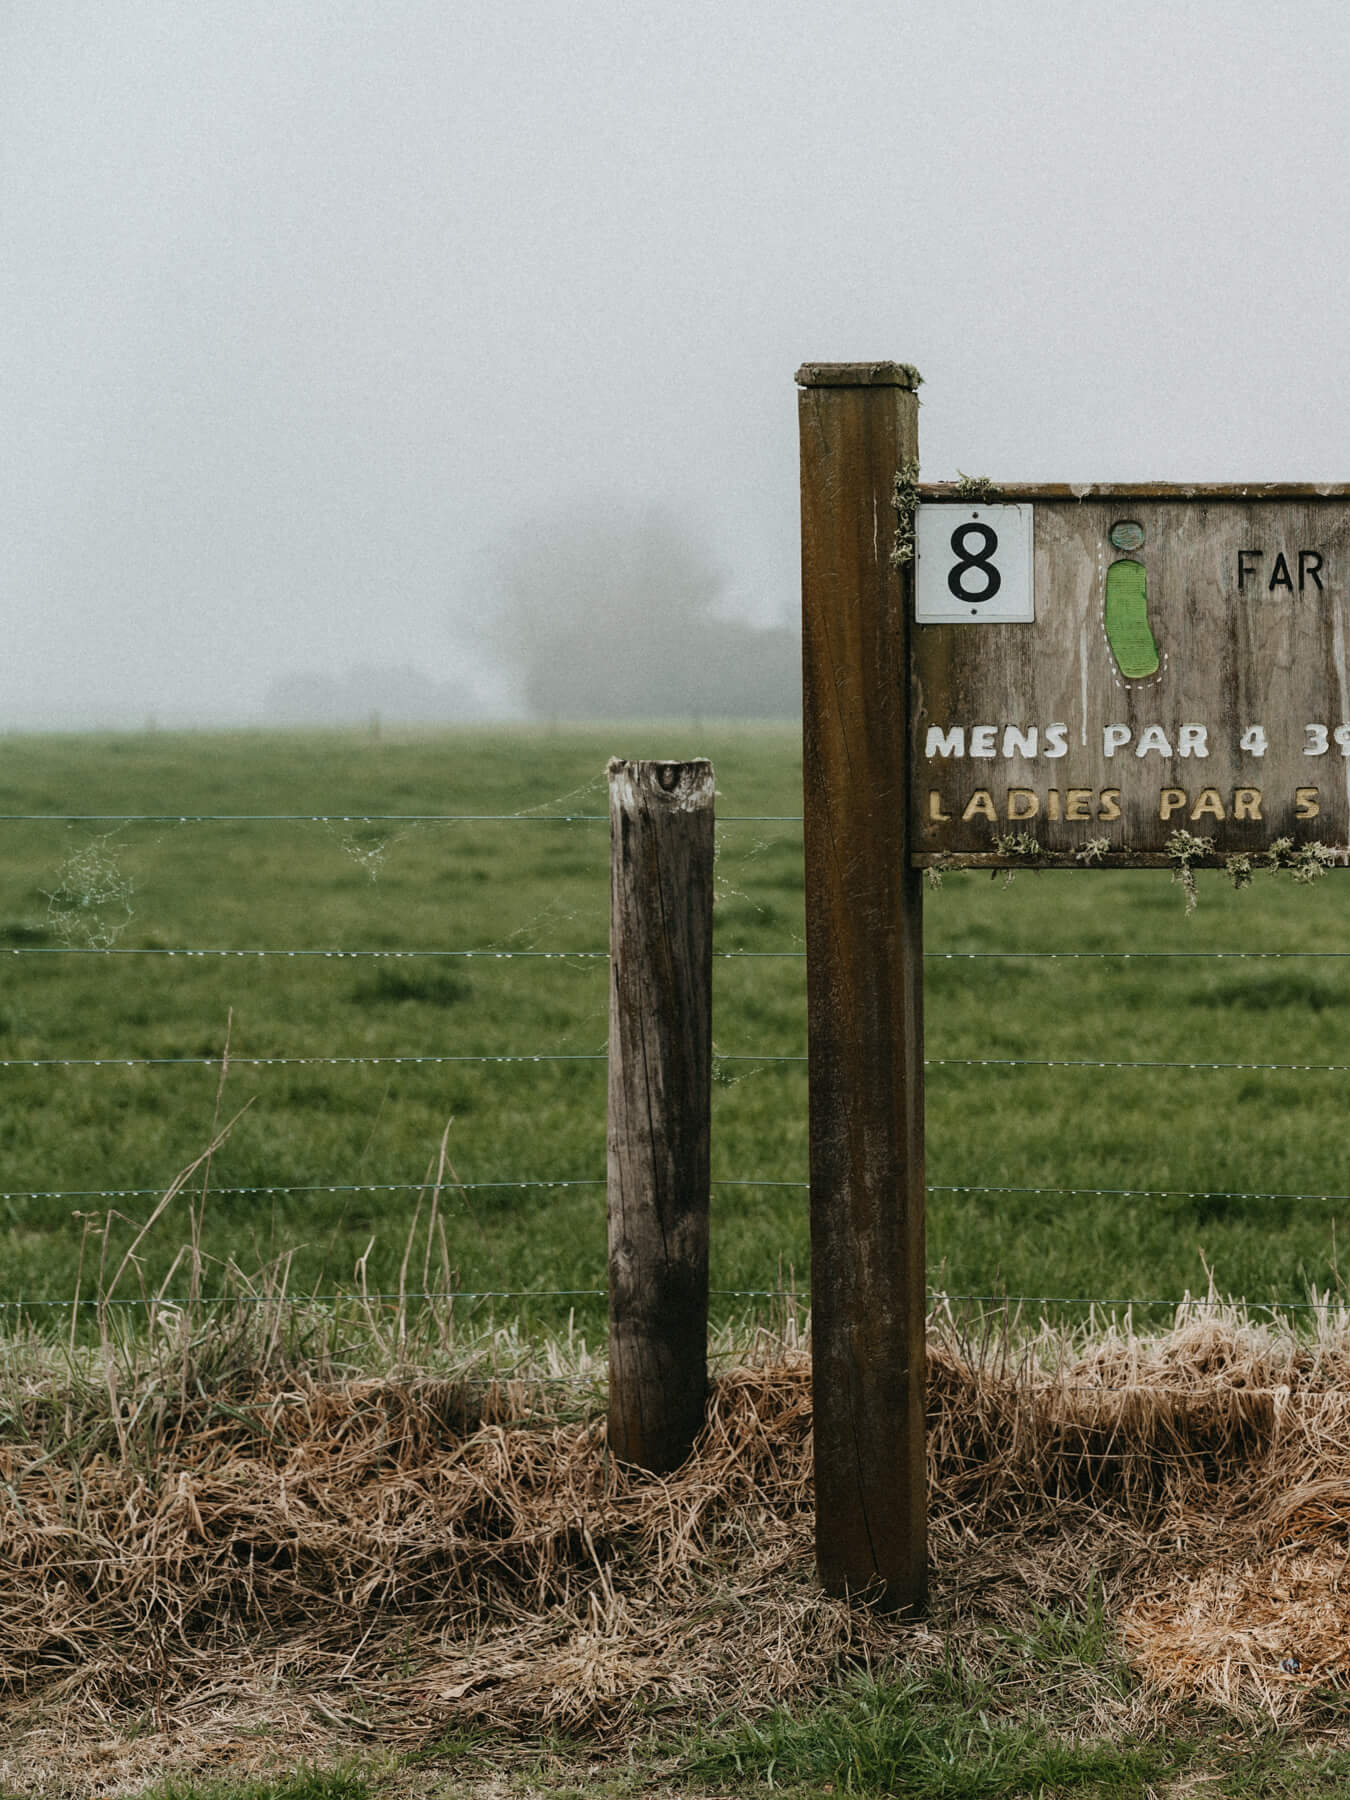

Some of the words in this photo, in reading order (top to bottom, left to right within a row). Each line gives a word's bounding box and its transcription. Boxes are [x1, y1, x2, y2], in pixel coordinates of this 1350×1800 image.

[948, 522, 1001, 602] 8
[1237, 550, 1324, 592] FAR
[925, 723, 1068, 758] MENS
[1103, 723, 1209, 758] PAR
[1240, 725, 1268, 757] 4
[929, 788, 1122, 822] LADIES
[1160, 788, 1263, 821] PAR
[1296, 787, 1320, 819] 5
